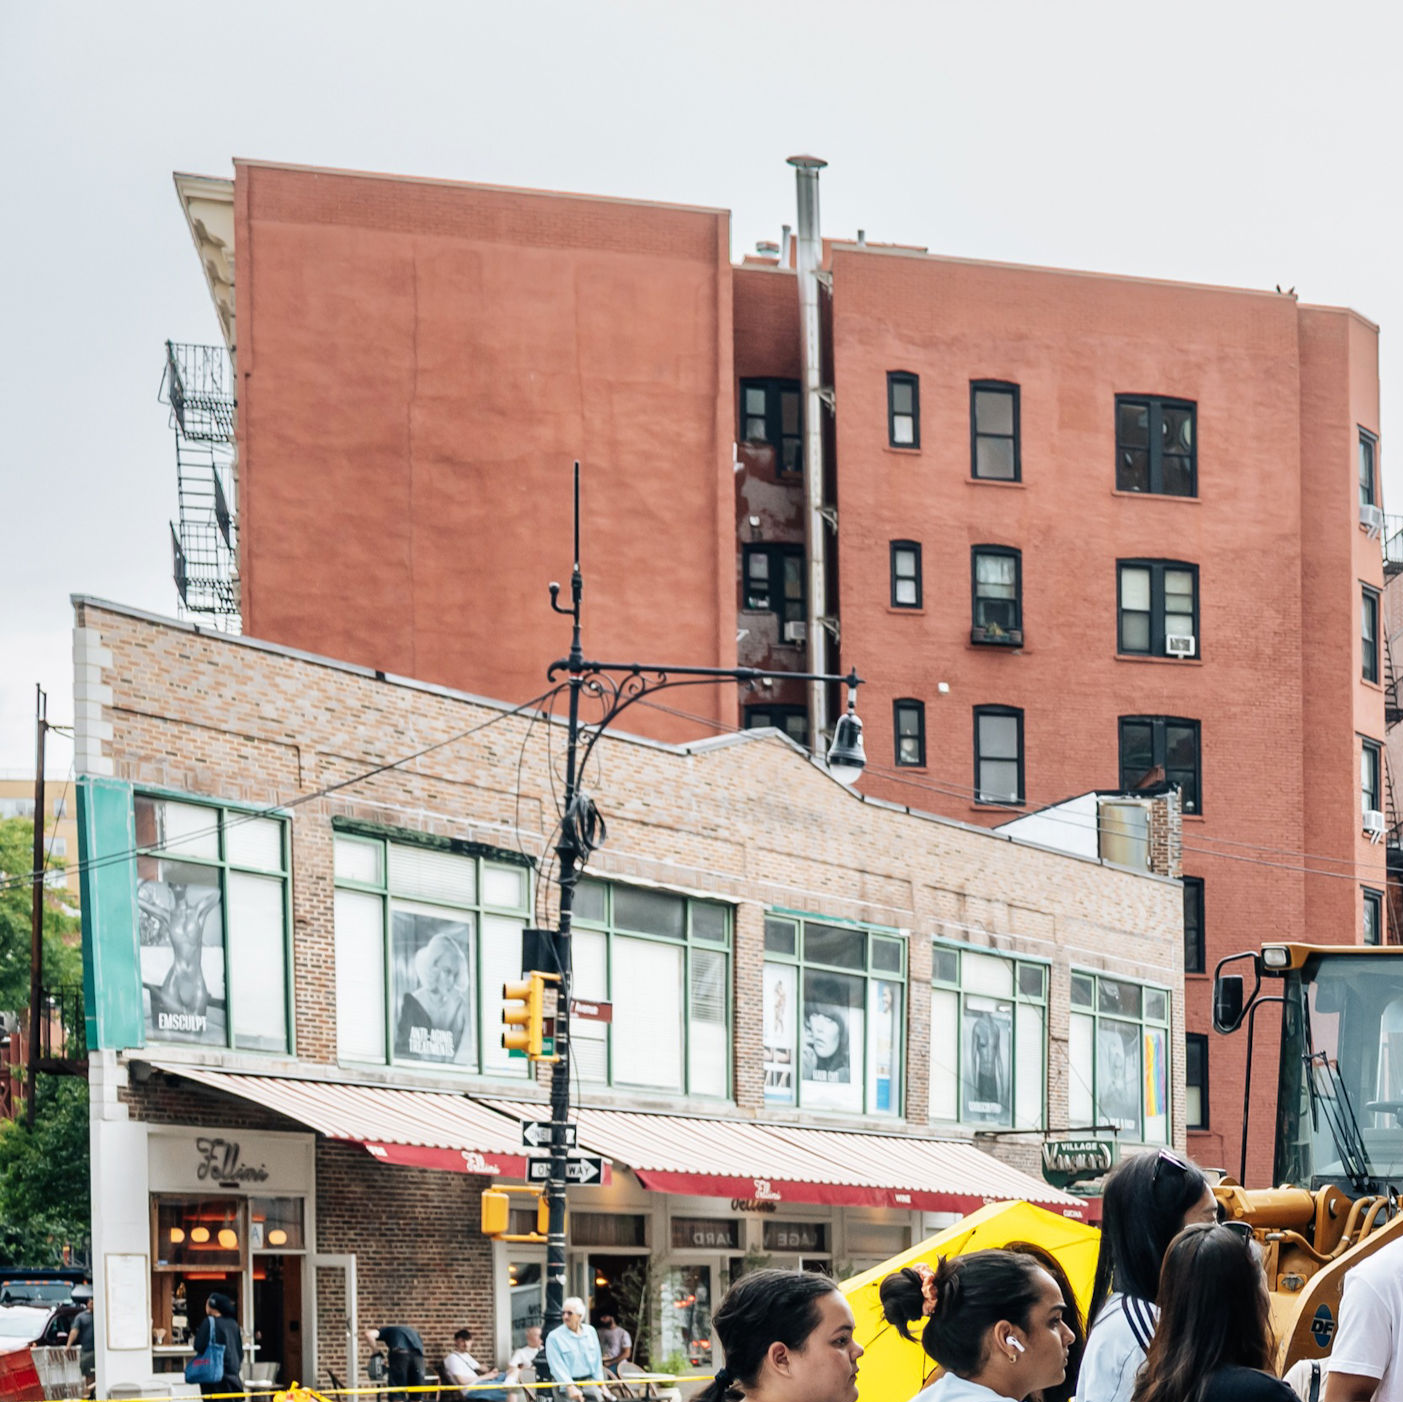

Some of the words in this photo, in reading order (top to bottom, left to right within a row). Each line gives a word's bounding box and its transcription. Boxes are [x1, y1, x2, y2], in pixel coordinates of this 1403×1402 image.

[158, 1012, 207, 1032] EMSCULPT
[1061, 1142, 1098, 1151] VILLAGE
[196, 1137, 269, 1182] Fellini
[537, 1162, 552, 1176] ON
[567, 1160, 592, 1177] WAY
[895, 1193, 911, 1204] WINE
[1311, 1318, 1336, 1334] DF
